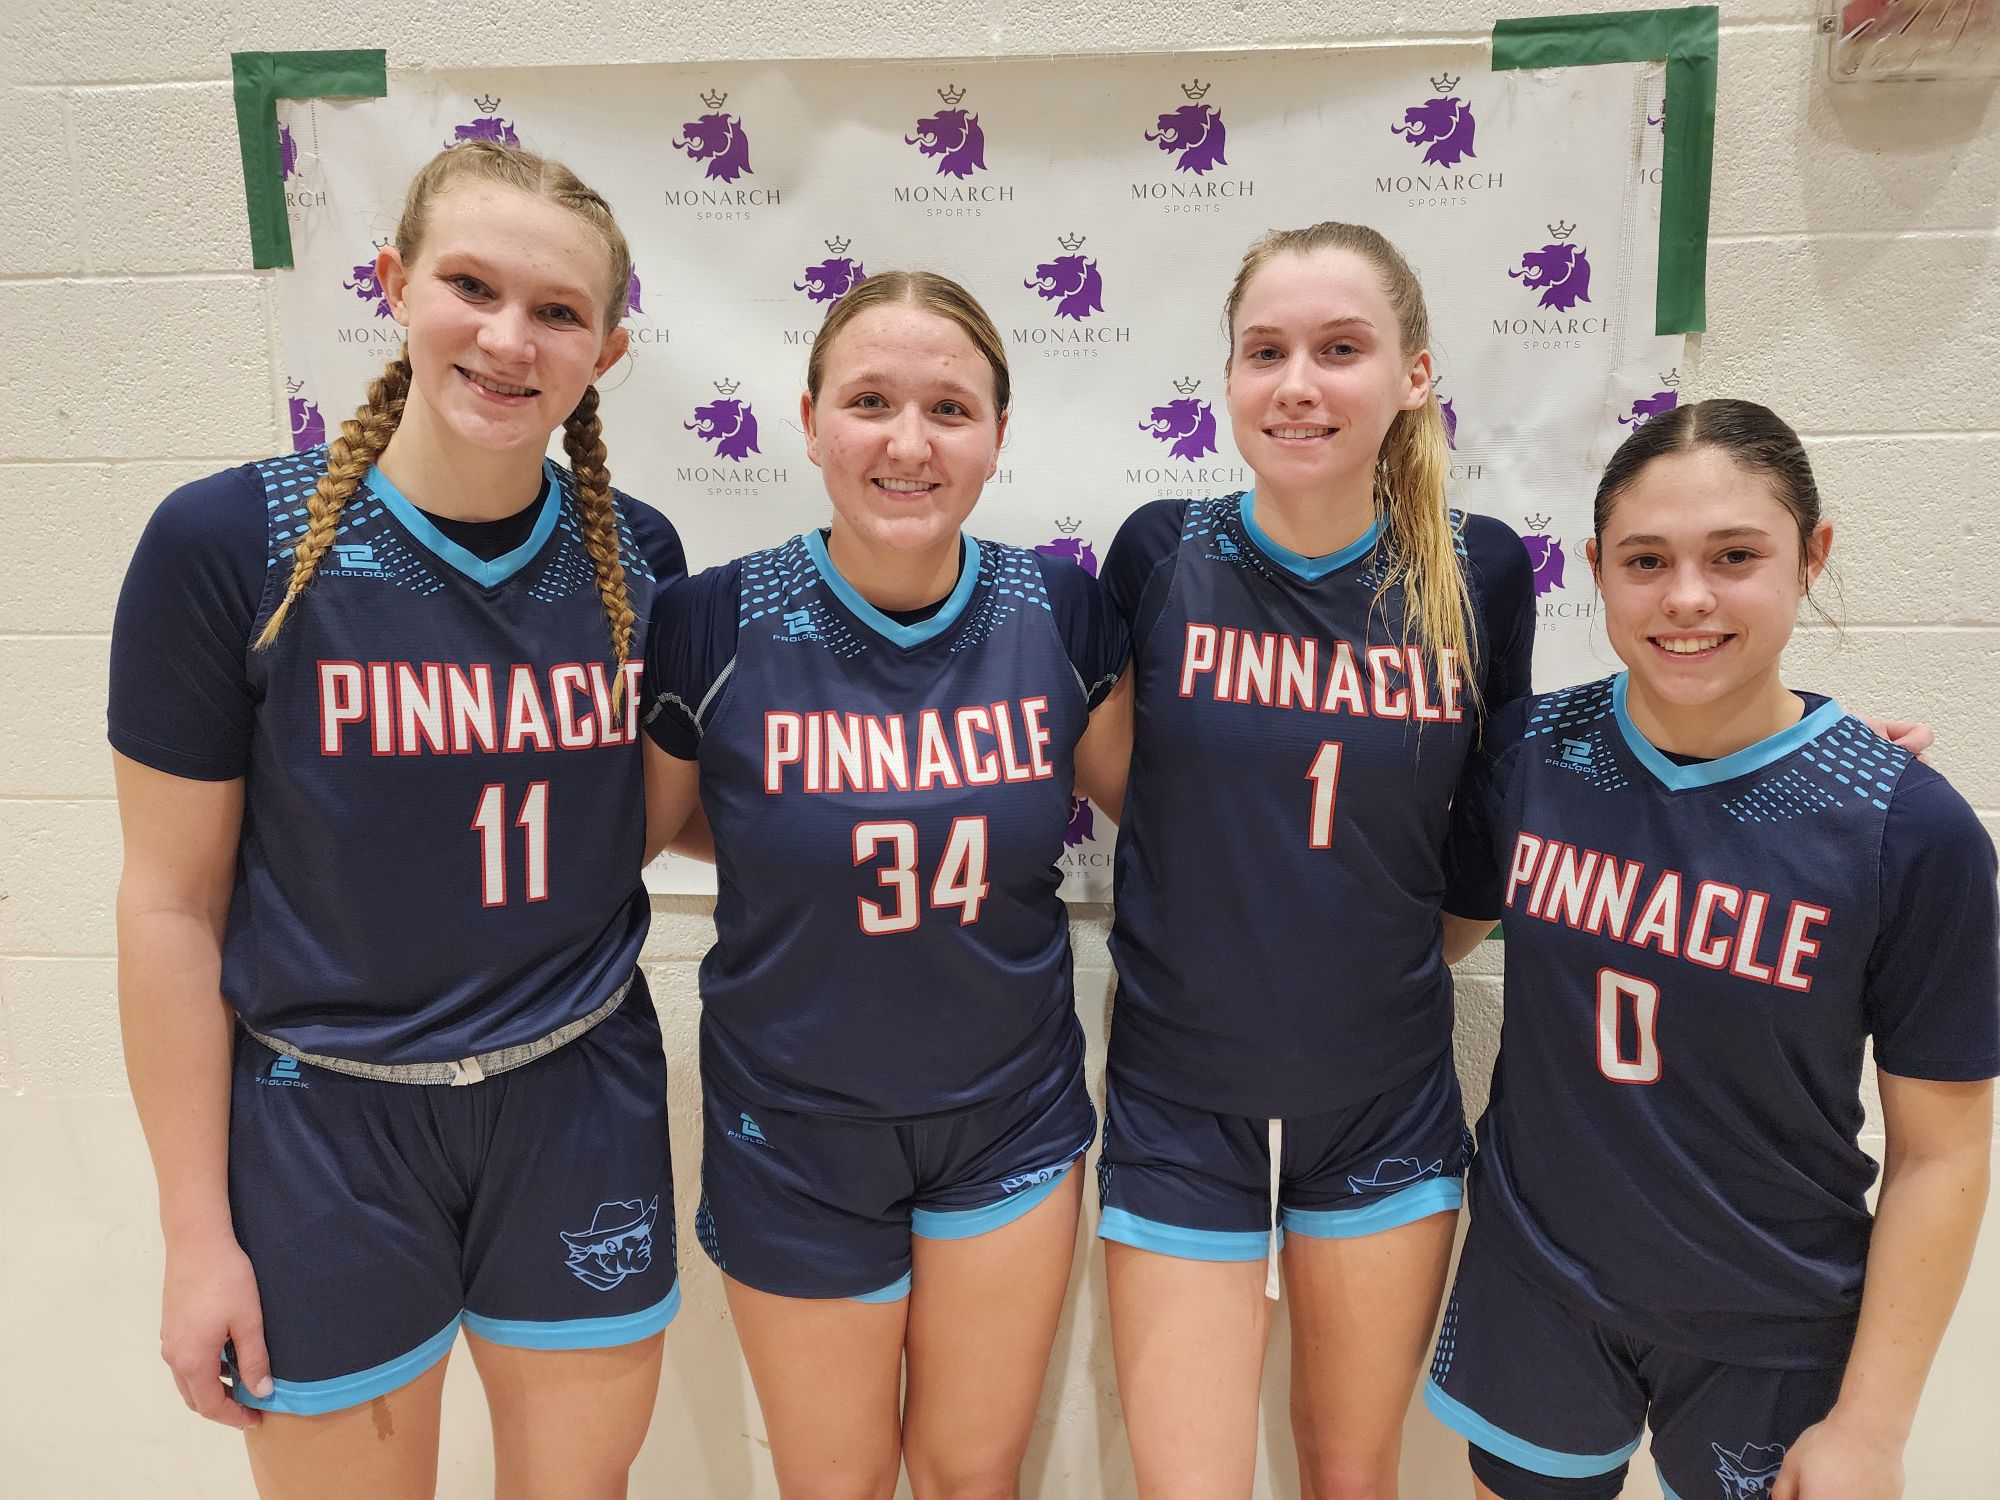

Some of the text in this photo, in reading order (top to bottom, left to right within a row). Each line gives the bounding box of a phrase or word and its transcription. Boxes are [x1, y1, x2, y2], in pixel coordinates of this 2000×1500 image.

[1131, 180, 1253, 199] MONARCH
[1375, 172, 1503, 193] MONARCH
[664, 189, 781, 206] MONARCH
[894, 185, 1013, 202] MONARCH
[1164, 204, 1220, 213] SPORTS
[1408, 197, 1467, 208] SPORTS
[697, 211, 750, 221] SPORTS
[926, 208, 981, 217] SPORTS
[338, 328, 409, 343] MONA
[1012, 327, 1130, 343] MONARCH
[1523, 340, 1581, 350] SPORTS
[1044, 349, 1098, 358] SPORTS
[677, 467, 787, 483] MONARCH
[1126, 468, 1243, 483] MONARCH
[707, 488, 758, 496] SPORTS
[1157, 488, 1211, 497] SPORTS
[320, 569, 394, 578] PROLOOK
[772, 633, 826, 642] PROLOOK
[1179, 621, 1463, 723] PINNACLE
[763, 695, 1054, 795] PINNACLE
[1544, 758, 1599, 775] PROLOOK
[1304, 740, 1344, 850] 1
[469, 780, 550, 908] 11
[1055, 853, 1114, 867] ARCH
[851, 815, 990, 936] 34
[1504, 830, 1832, 993] PINNACLE
[1595, 966, 1663, 1086] 0
[727, 1130, 775, 1150] PROLO
